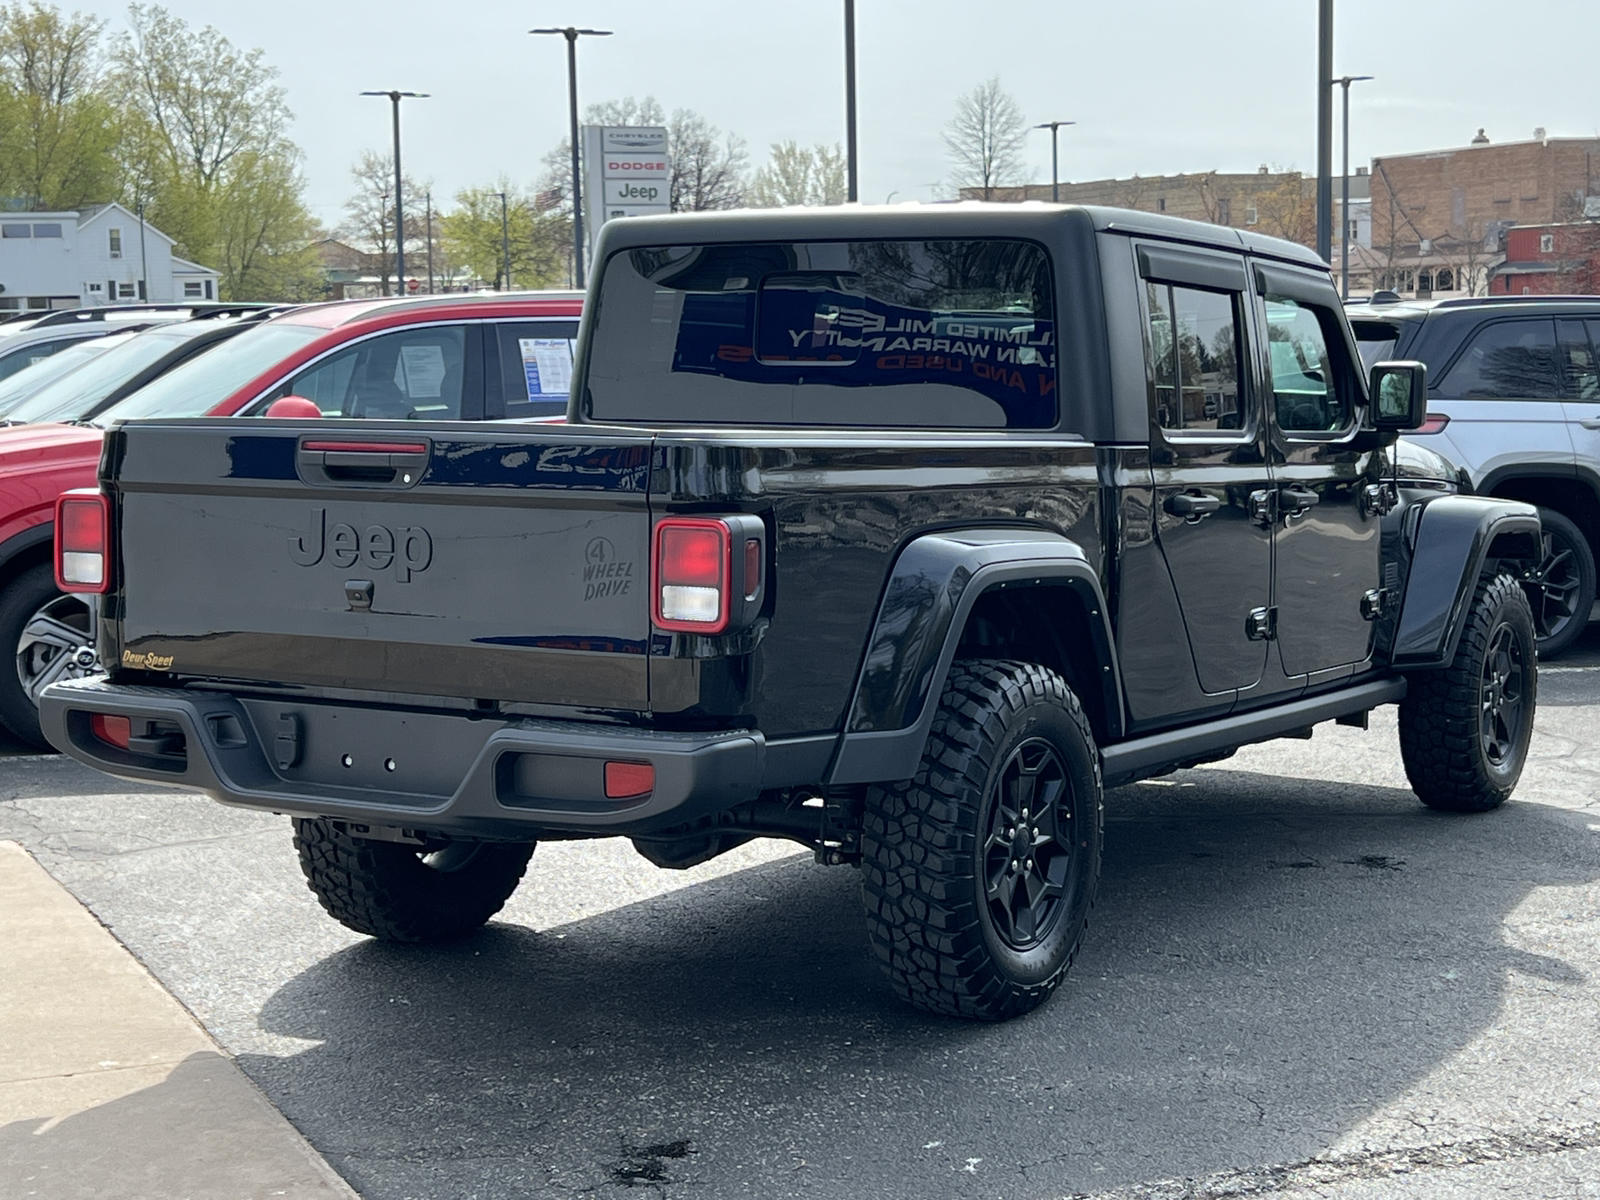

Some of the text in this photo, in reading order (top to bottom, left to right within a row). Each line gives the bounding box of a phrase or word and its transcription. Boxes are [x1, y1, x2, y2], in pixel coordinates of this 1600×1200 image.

[608, 162, 665, 170] DODGE
[618, 183, 658, 201] Jeep
[288, 508, 434, 584] Jeep
[583, 562, 633, 583] WHEEL
[584, 580, 633, 601] DRIVE
[122, 649, 146, 663] Deur
[145, 652, 174, 667] Speet
